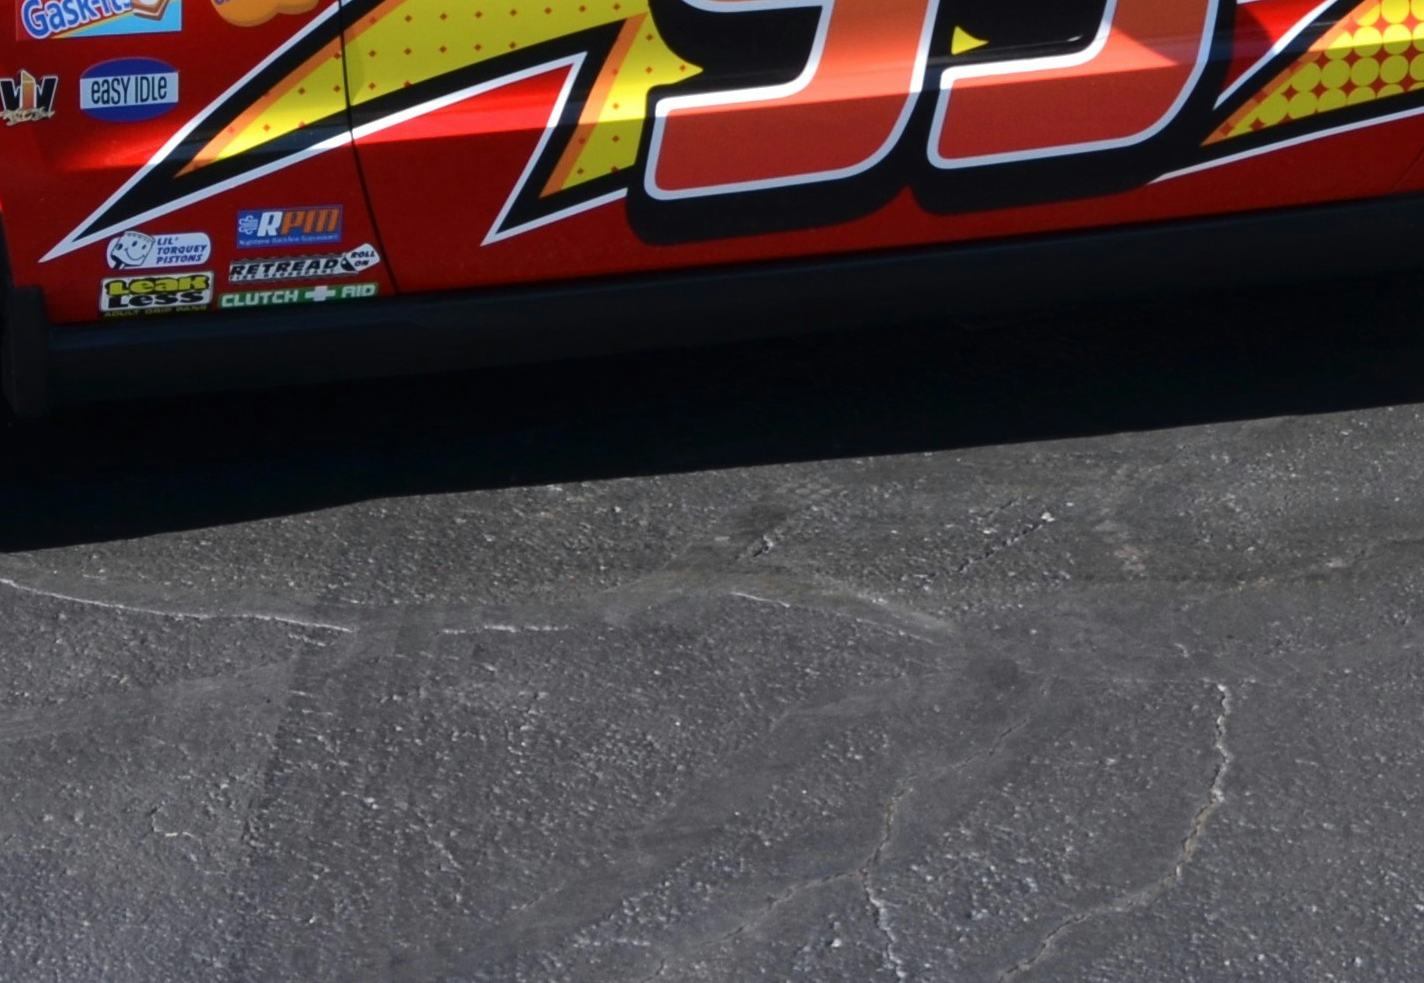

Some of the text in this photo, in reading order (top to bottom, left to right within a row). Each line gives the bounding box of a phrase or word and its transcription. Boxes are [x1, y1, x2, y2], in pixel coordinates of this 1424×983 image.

[156, 243, 208, 255] TORQUEY
[350, 250, 376, 259] ROLL
[155, 254, 204, 265] PISTONS
[354, 258, 370, 267] ON
[230, 258, 339, 276] RETREAD
[221, 283, 376, 308] CLUTCH AID
